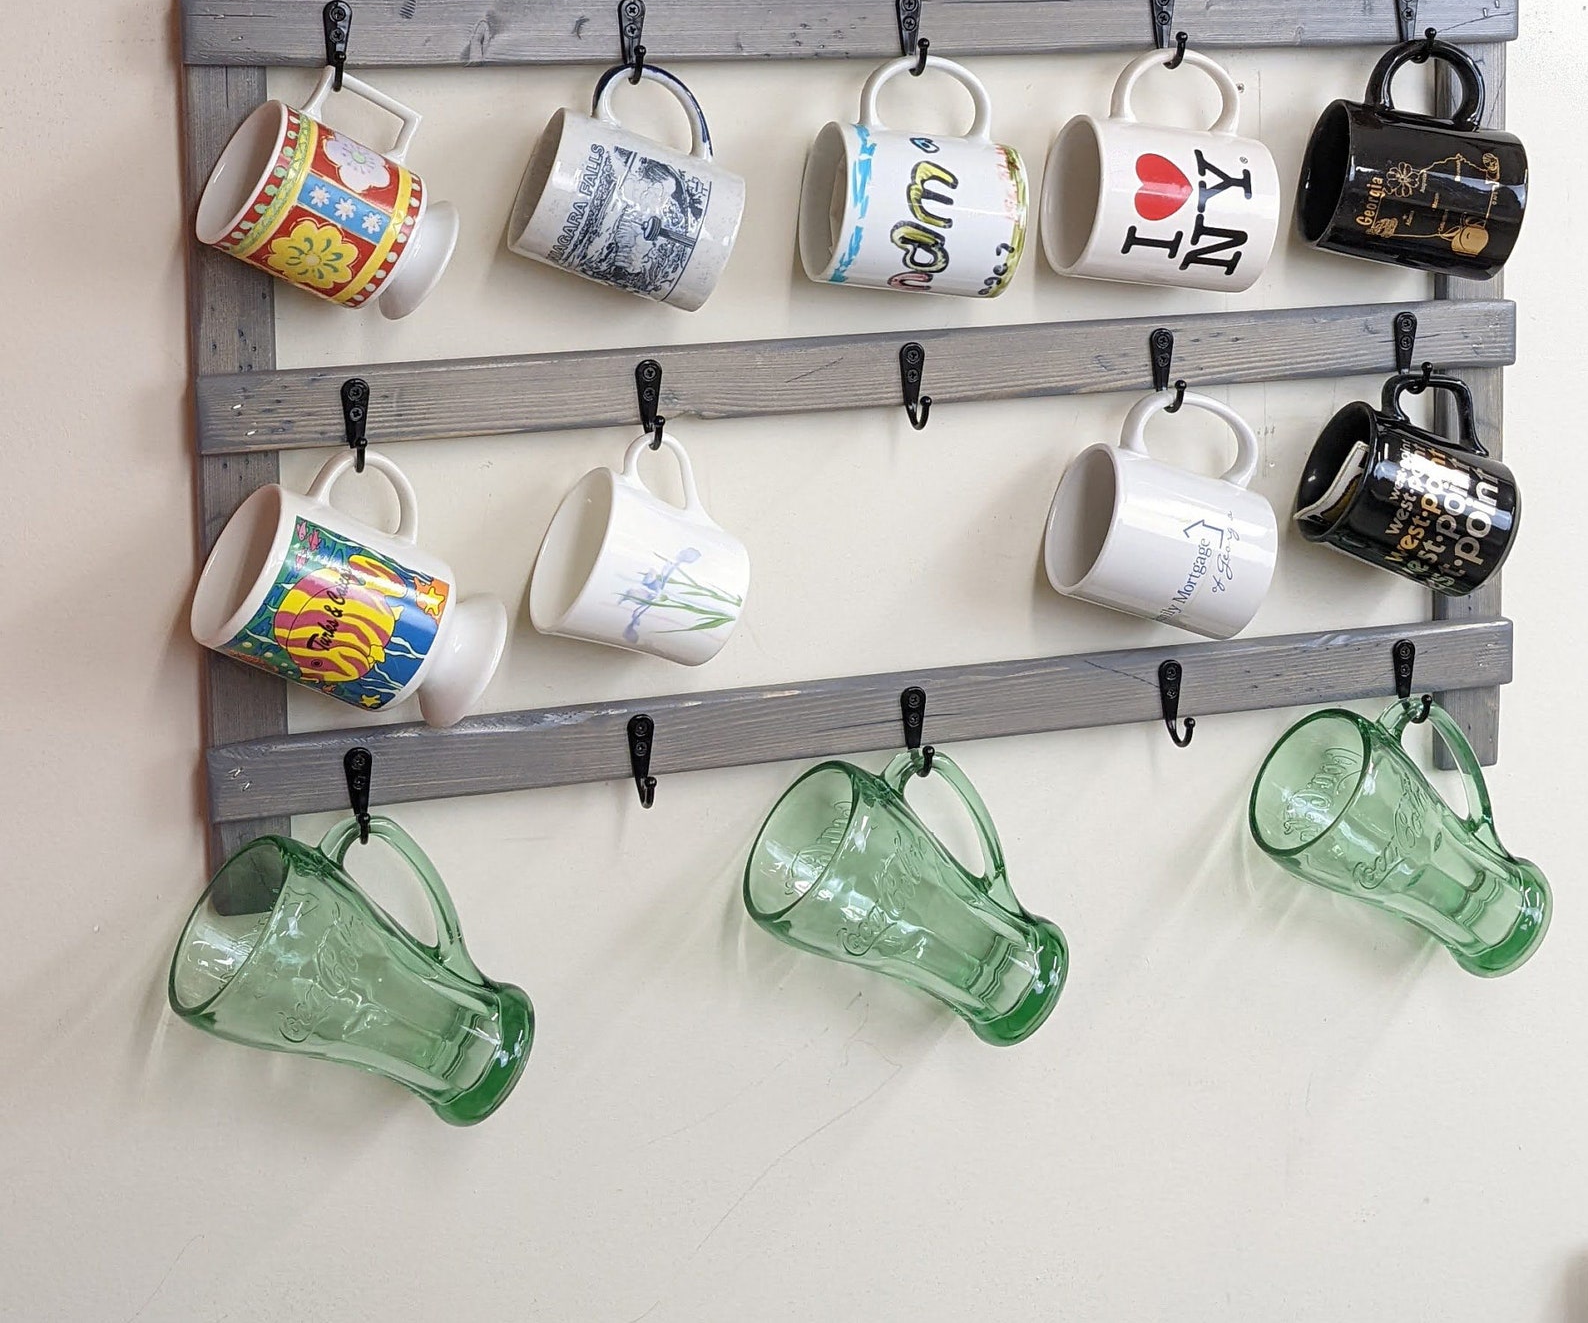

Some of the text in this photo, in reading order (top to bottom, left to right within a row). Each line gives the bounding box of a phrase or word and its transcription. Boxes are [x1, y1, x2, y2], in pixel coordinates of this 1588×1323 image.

[579, 143, 605, 197] FALLS
[1355, 176, 1386, 227] Georgia
[1121, 225, 1184, 259] I
[1172, 538, 1213, 604] Mortgage
[1212, 510, 1240, 593] of Georga
[306, 618, 340, 652] Turks
[323, 604, 344, 618] &
